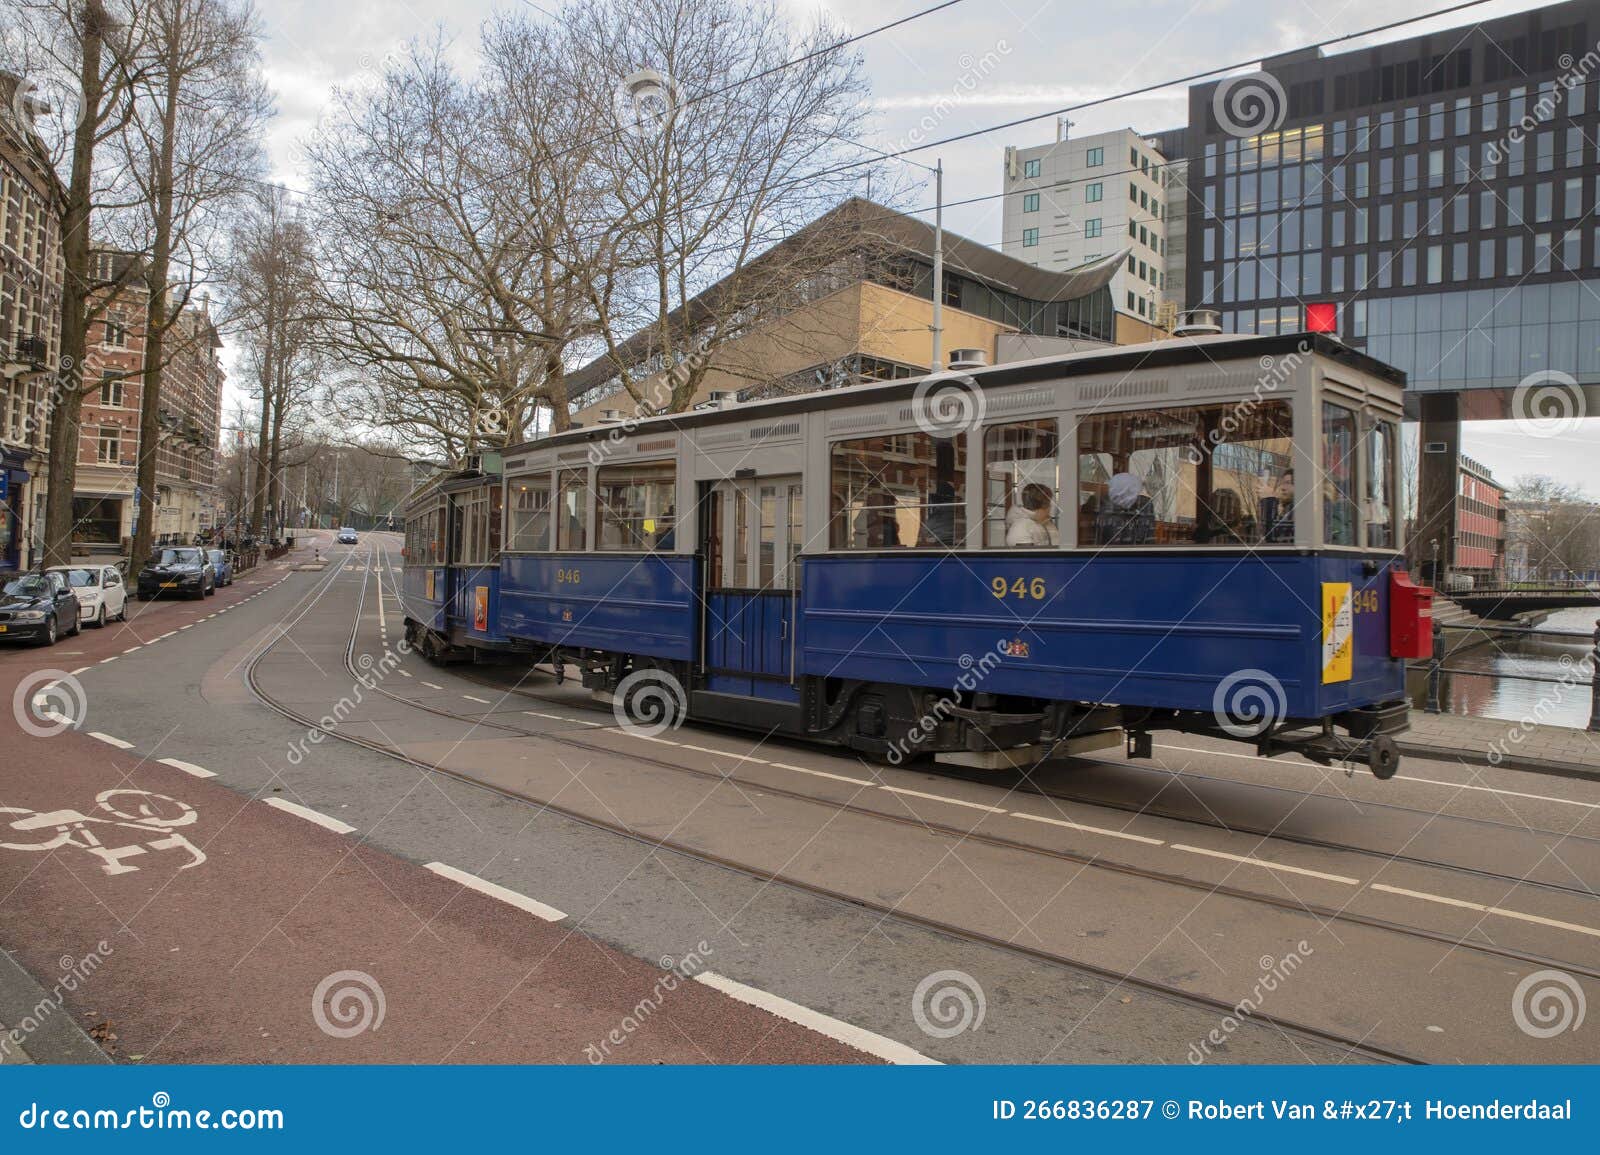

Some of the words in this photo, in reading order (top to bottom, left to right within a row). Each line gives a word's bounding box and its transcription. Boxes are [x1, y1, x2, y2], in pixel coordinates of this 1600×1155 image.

[557, 569, 581, 583] 946
[992, 576, 1046, 600] 946
[1352, 590, 1379, 614] 946
